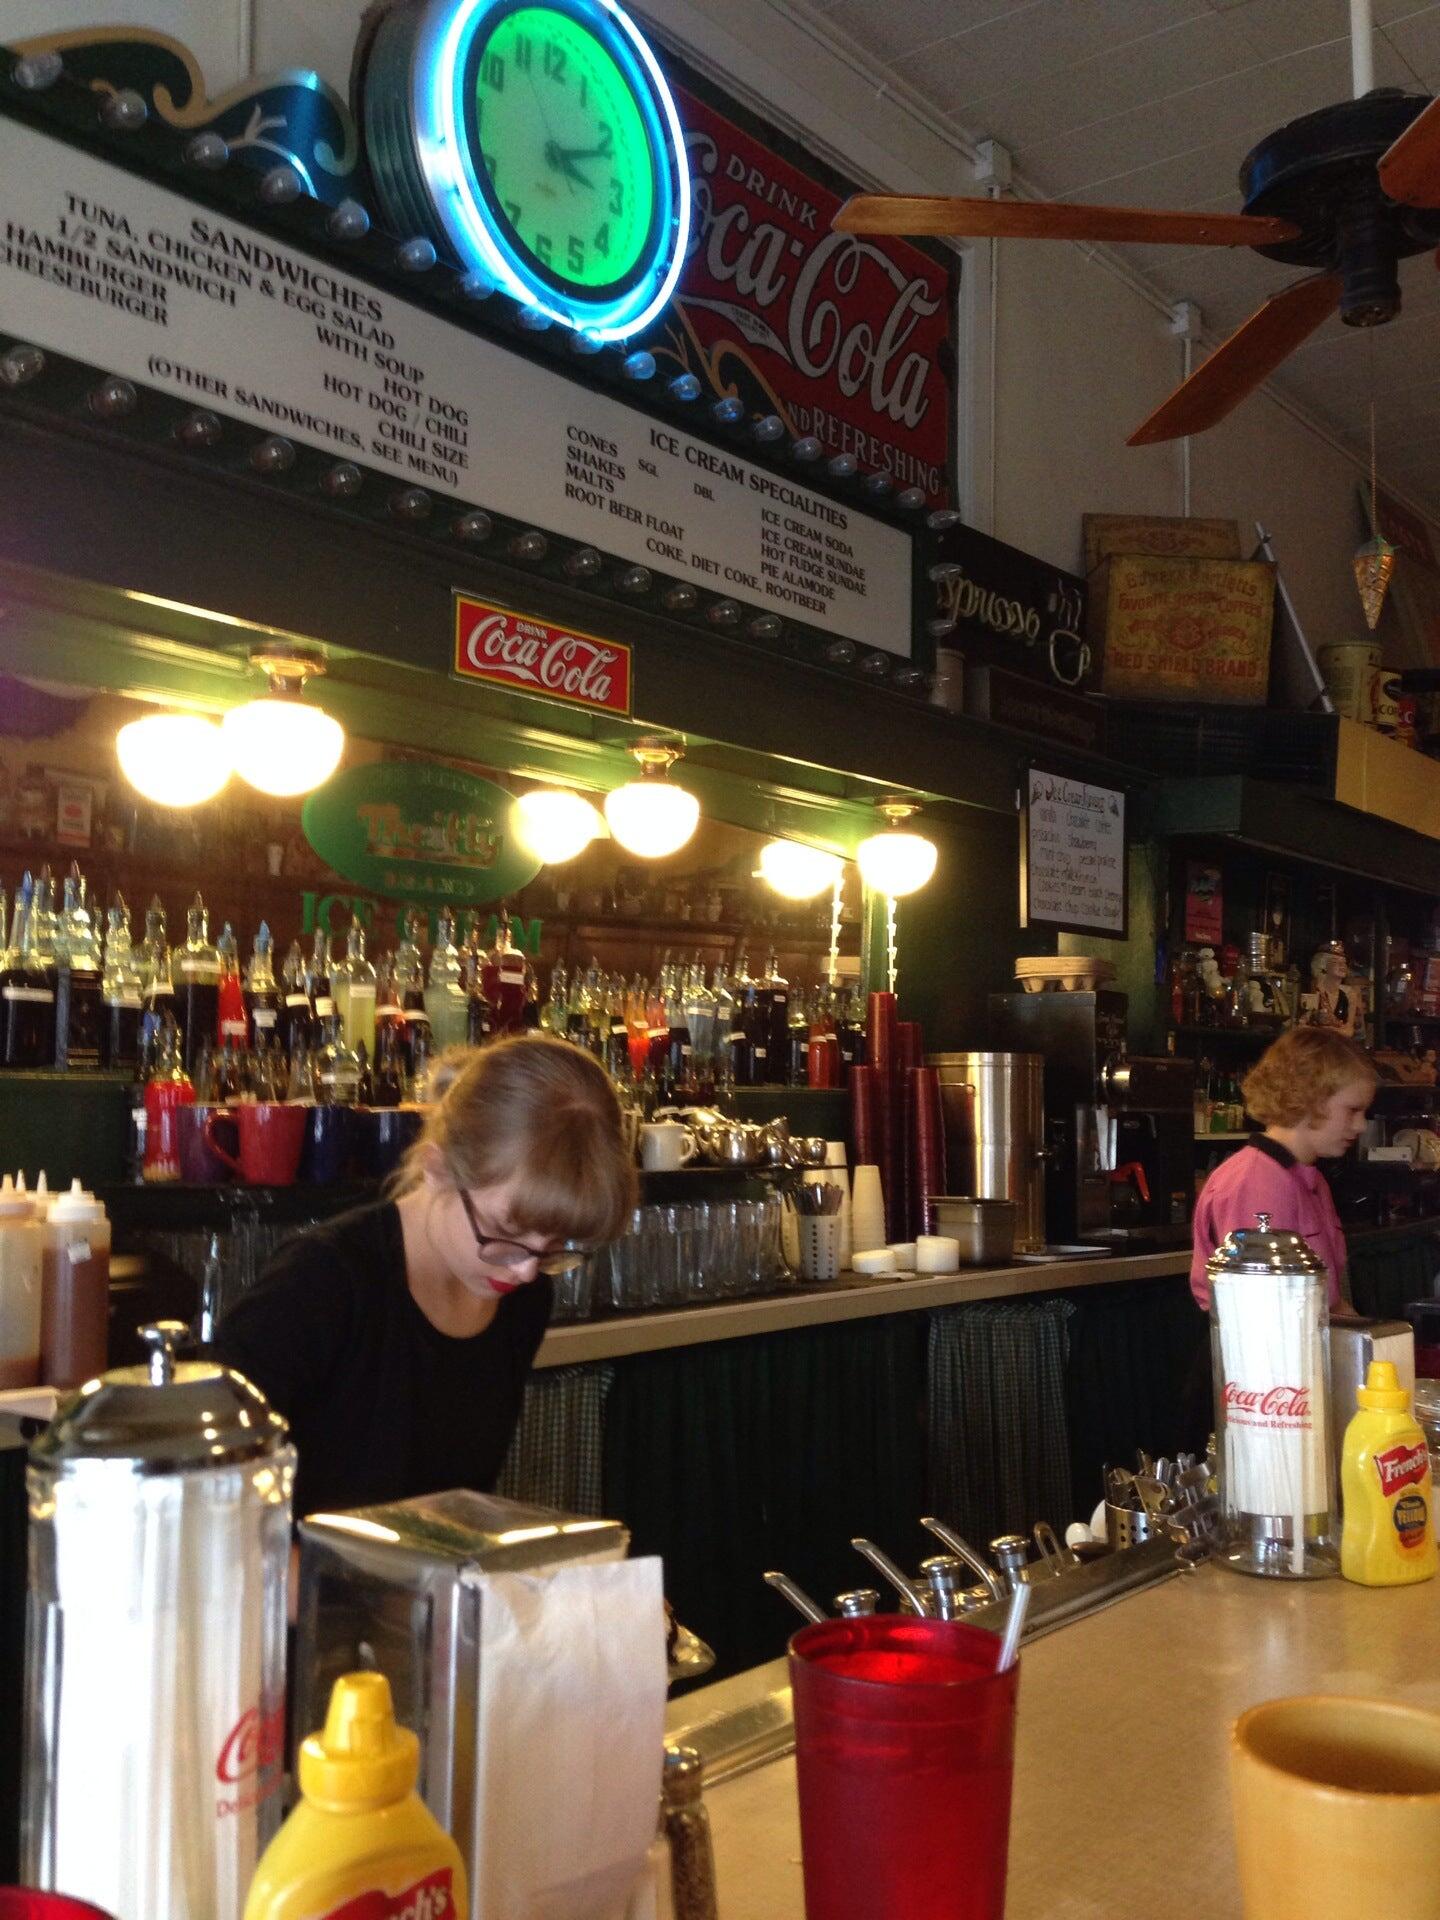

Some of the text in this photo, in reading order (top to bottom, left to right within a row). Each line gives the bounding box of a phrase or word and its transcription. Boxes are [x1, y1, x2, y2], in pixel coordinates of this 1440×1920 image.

[482, 50, 504, 93] 10
[515, 33, 532, 74] 11
[544, 41, 567, 85] 12
[609, 177, 624, 218] 3
[726, 155, 818, 230] DRINK
[567, 235, 584, 275] 5
[594, 222, 610, 258] 4
[65, 190, 395, 351] TUNA, CHICKEN & EGG SALAD
[190, 217, 383, 322] SANDWICHES
[6, 219, 470, 426] HAMBURGER HOT DOG
[58, 216, 425, 385] 1/2 SANDWICH WITH SOUP
[148, 356, 458, 488] (OTHER SANDWICHES, SEE MENU)
[324, 373, 363, 403] HOT
[368, 392, 407, 422] DOG
[425, 416, 468, 447] CHILI
[379, 421, 470, 470] CHILI SIZE
[566, 425, 618, 458] CONES
[638, 458, 659, 477] SGL
[566, 445, 626, 480] SHAKES
[813, 405, 940, 496] REFRESHING
[565, 462, 614, 493] MALTS
[650, 428, 847, 530] ICE CREAM SPECIALITIES
[564, 483, 685, 541] ROOT BEER FLOAT
[761, 508, 854, 558] ICE CREAM SODA
[646, 538, 826, 615] COKE, DIET COKE, ROOTBEER
[761, 527, 866, 581] ICE CREAM SUNDAE
[761, 543, 867, 596] HOT FUDGE SUNDAE
[760, 561, 836, 600] PIE ALAMODE
[516, 622, 547, 639] DRINK
[467, 614, 618, 701] Coca-Cola
[1221, 1381, 1311, 1417] Coca-Cola
